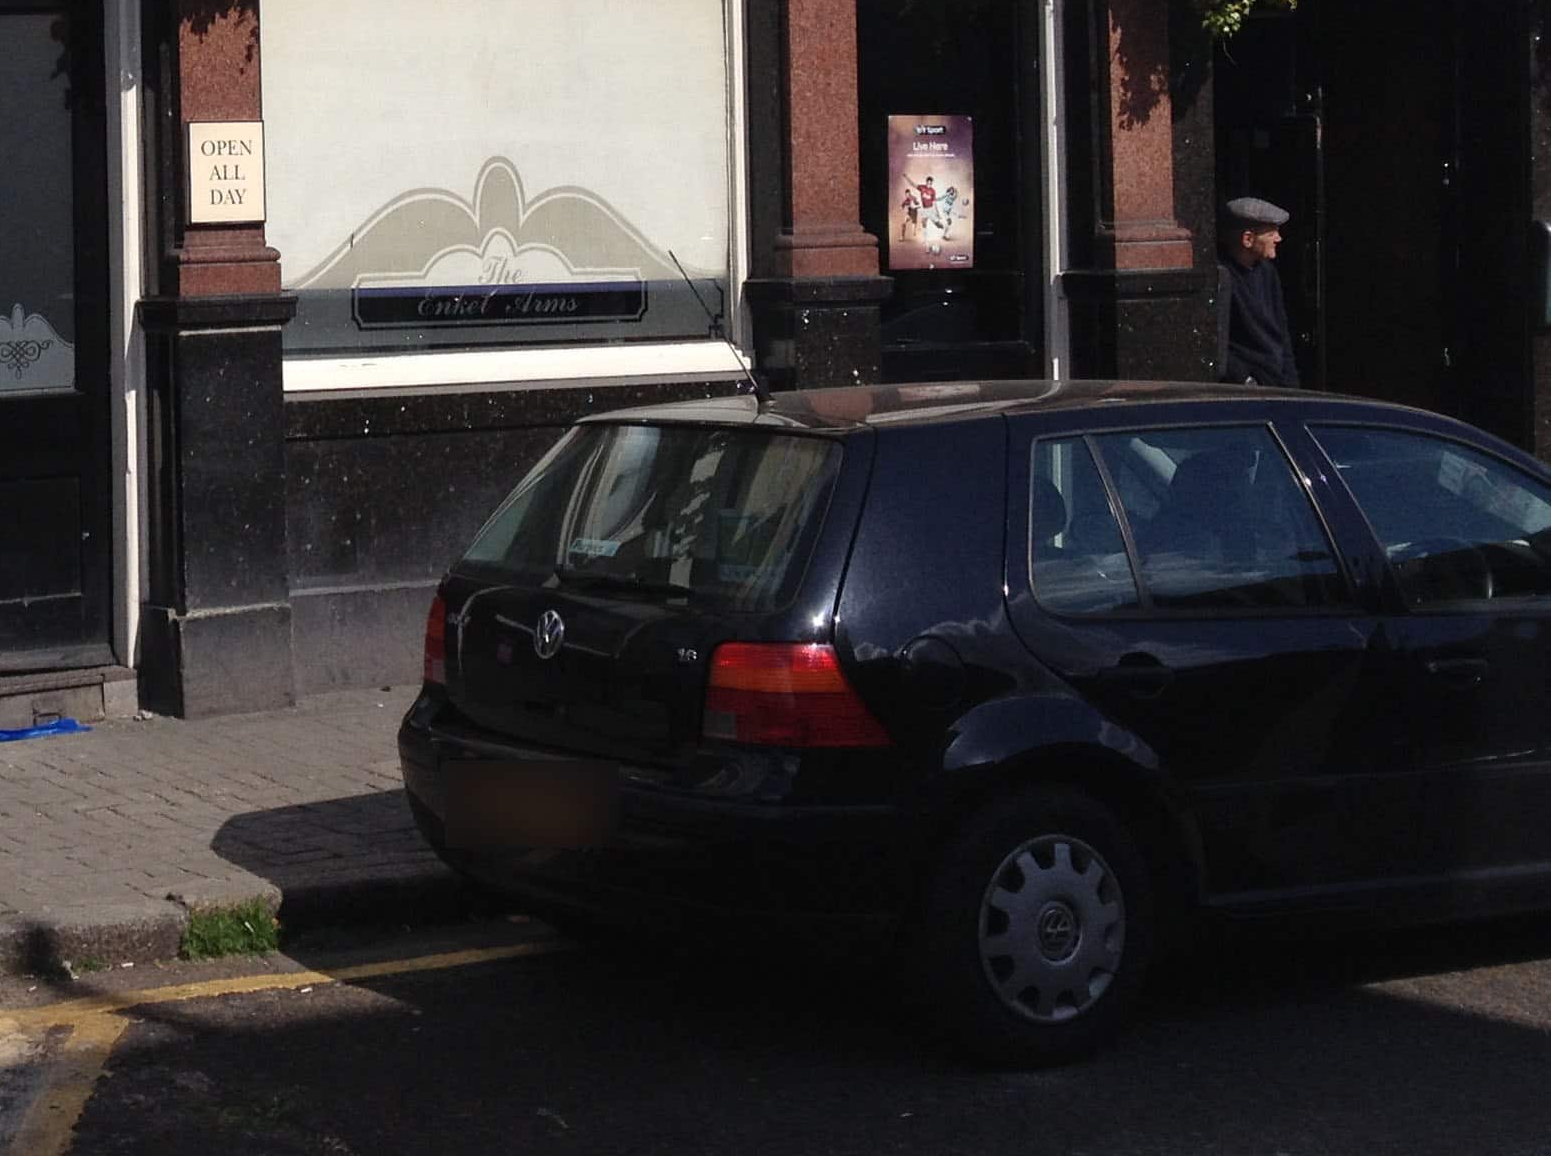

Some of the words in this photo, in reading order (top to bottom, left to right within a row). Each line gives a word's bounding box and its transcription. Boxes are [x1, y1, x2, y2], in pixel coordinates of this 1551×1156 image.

[200, 139, 253, 157] OPEN
[209, 163, 246, 181] ALL
[209, 188, 247, 205] DAY
[478, 255, 524, 285] The
[417, 288, 497, 316] Enkel
[505, 290, 578, 314] Arms
